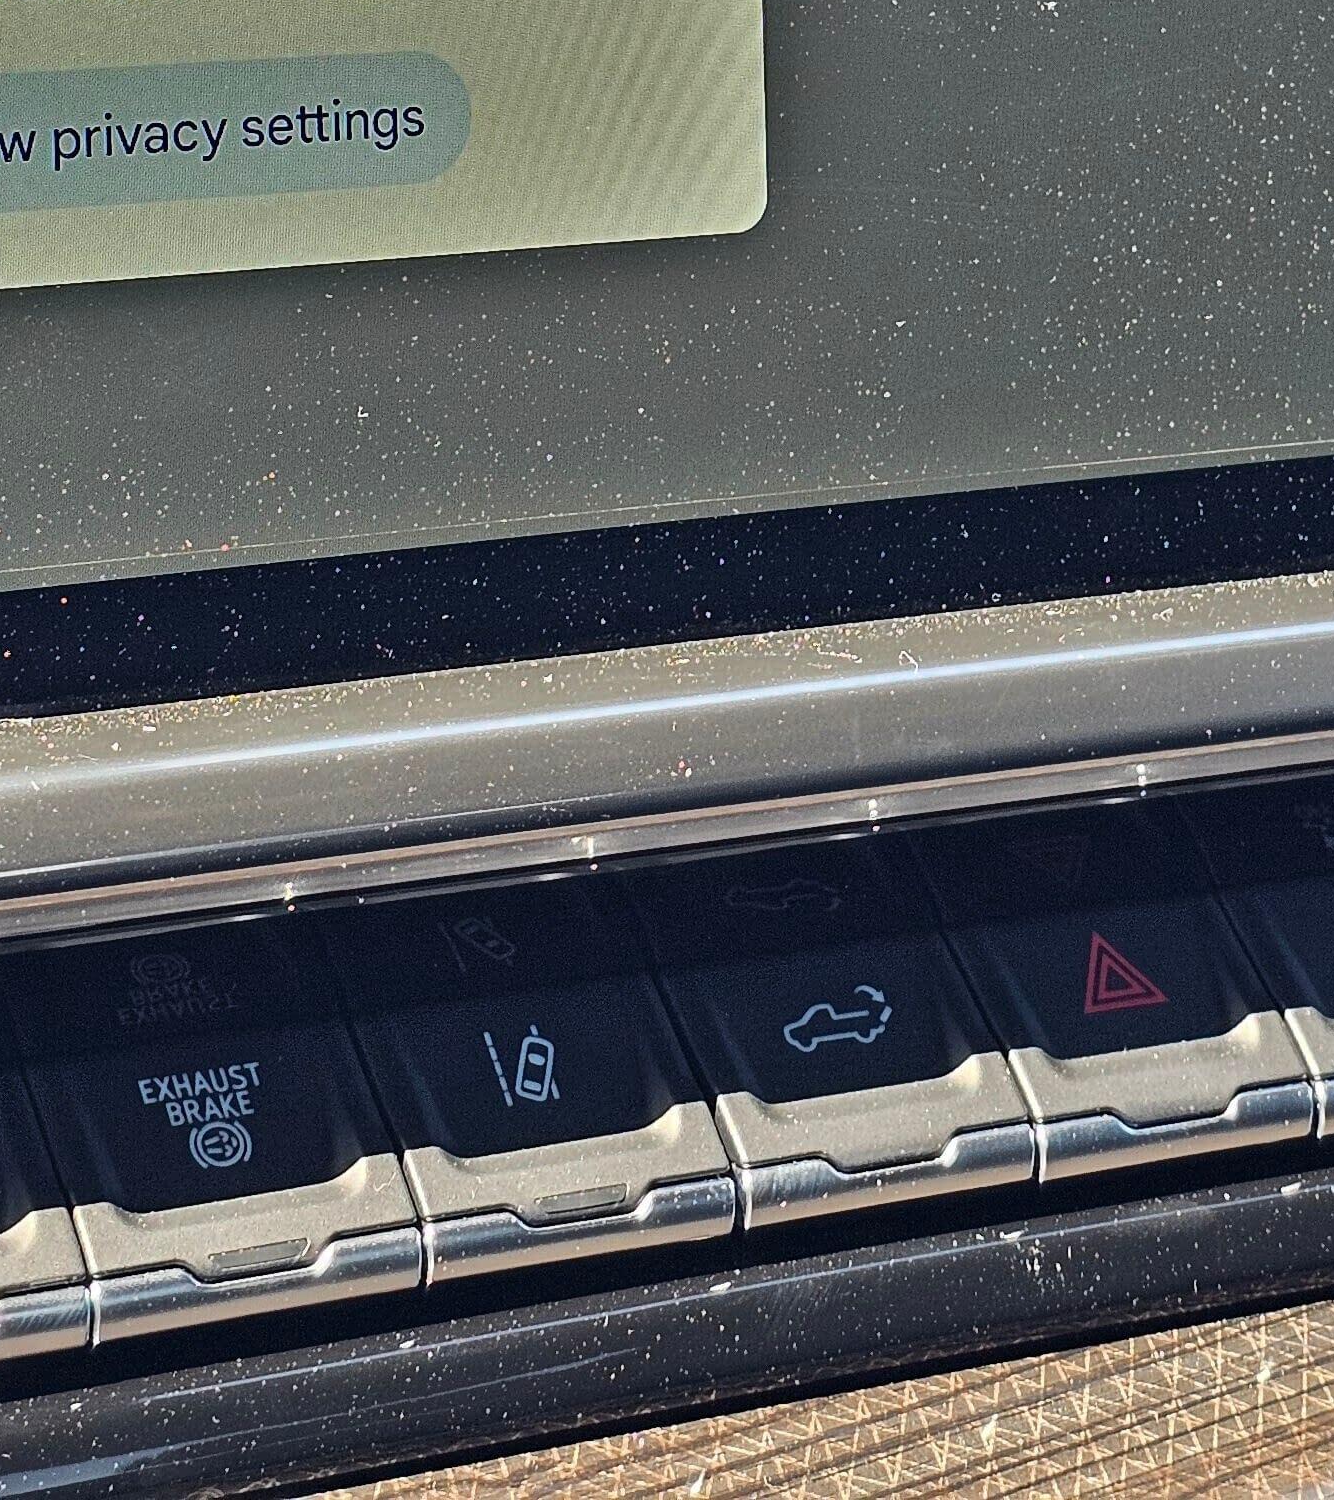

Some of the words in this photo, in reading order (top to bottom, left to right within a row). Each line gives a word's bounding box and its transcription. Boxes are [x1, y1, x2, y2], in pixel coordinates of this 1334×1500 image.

[54, 112, 228, 171] privacy
[242, 98, 425, 152] settings
[138, 1061, 260, 1105] EXHAUST
[165, 1090, 255, 1127] BRAKE
